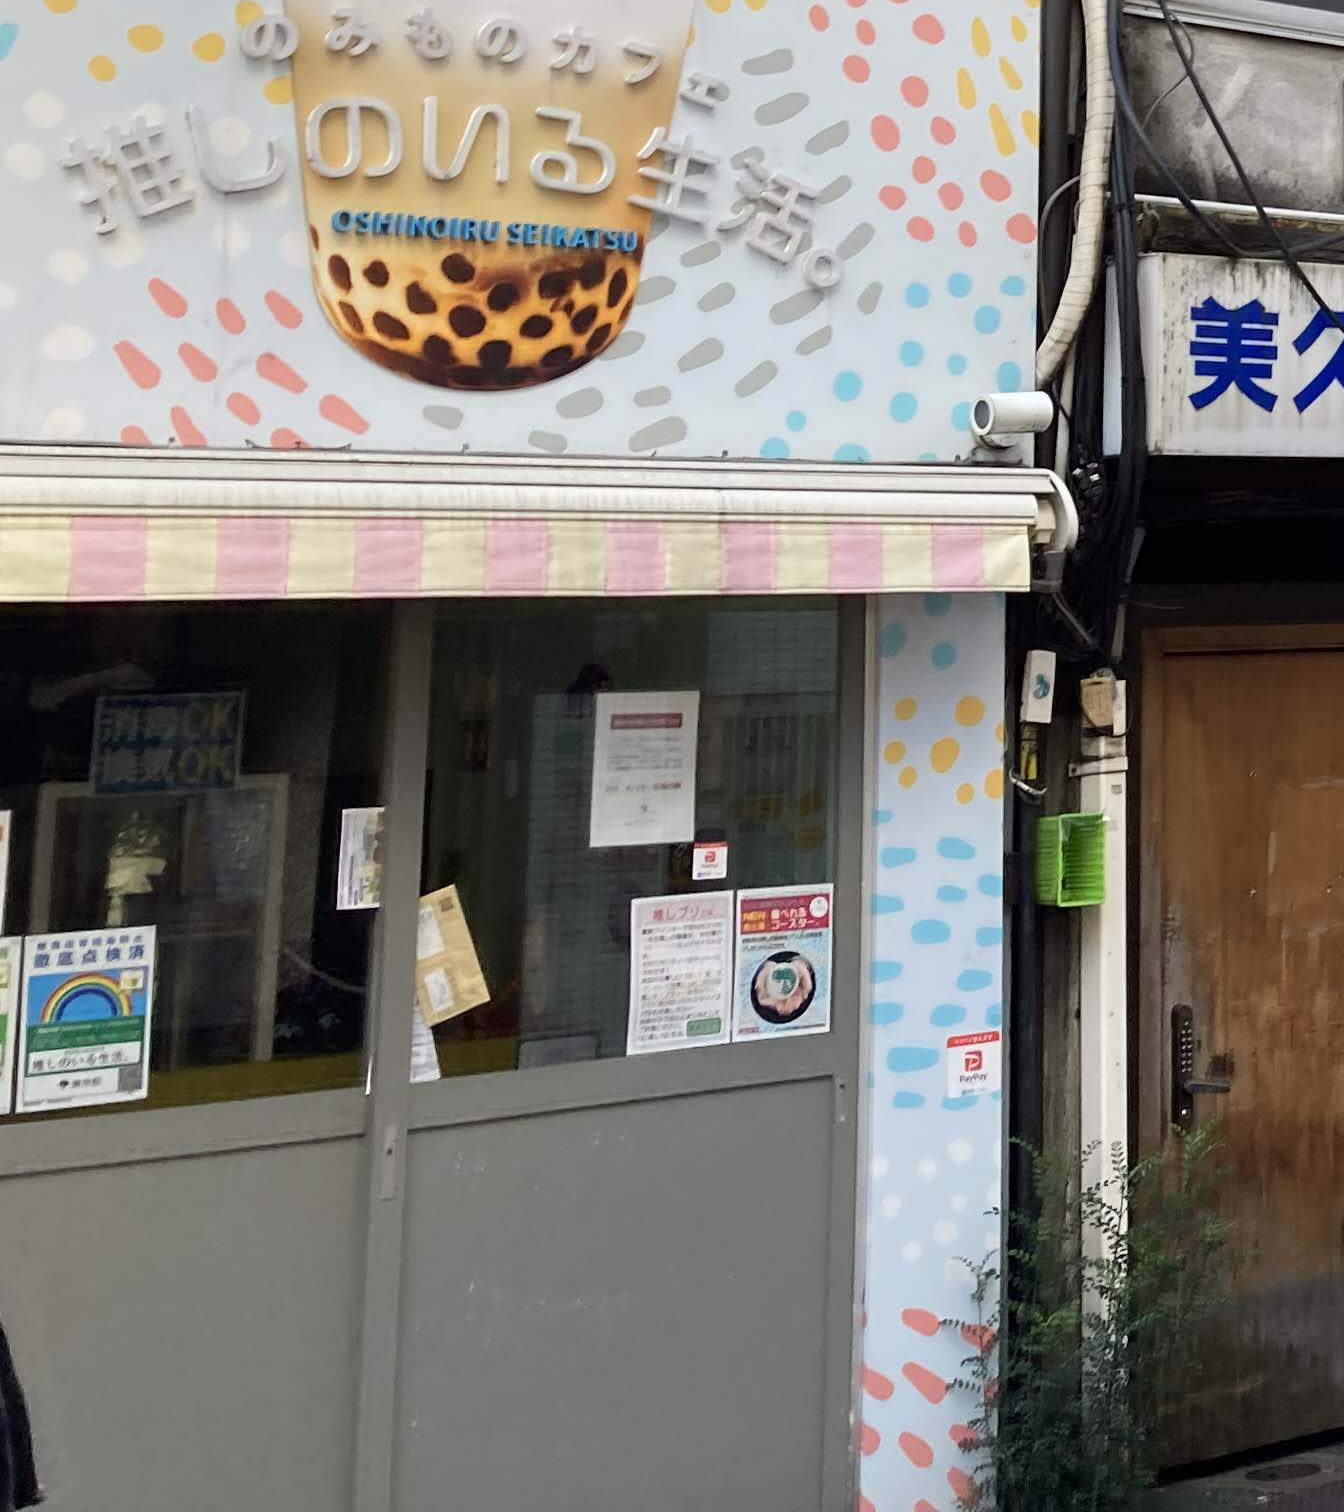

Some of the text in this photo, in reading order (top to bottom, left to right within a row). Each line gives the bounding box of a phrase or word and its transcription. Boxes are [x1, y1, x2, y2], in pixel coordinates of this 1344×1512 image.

[240, 6, 730, 112] のみものカフェ
[62, 93, 843, 288] 推しのいる生活。
[331, 208, 639, 253] OSHINOIRU SEIKATSU
